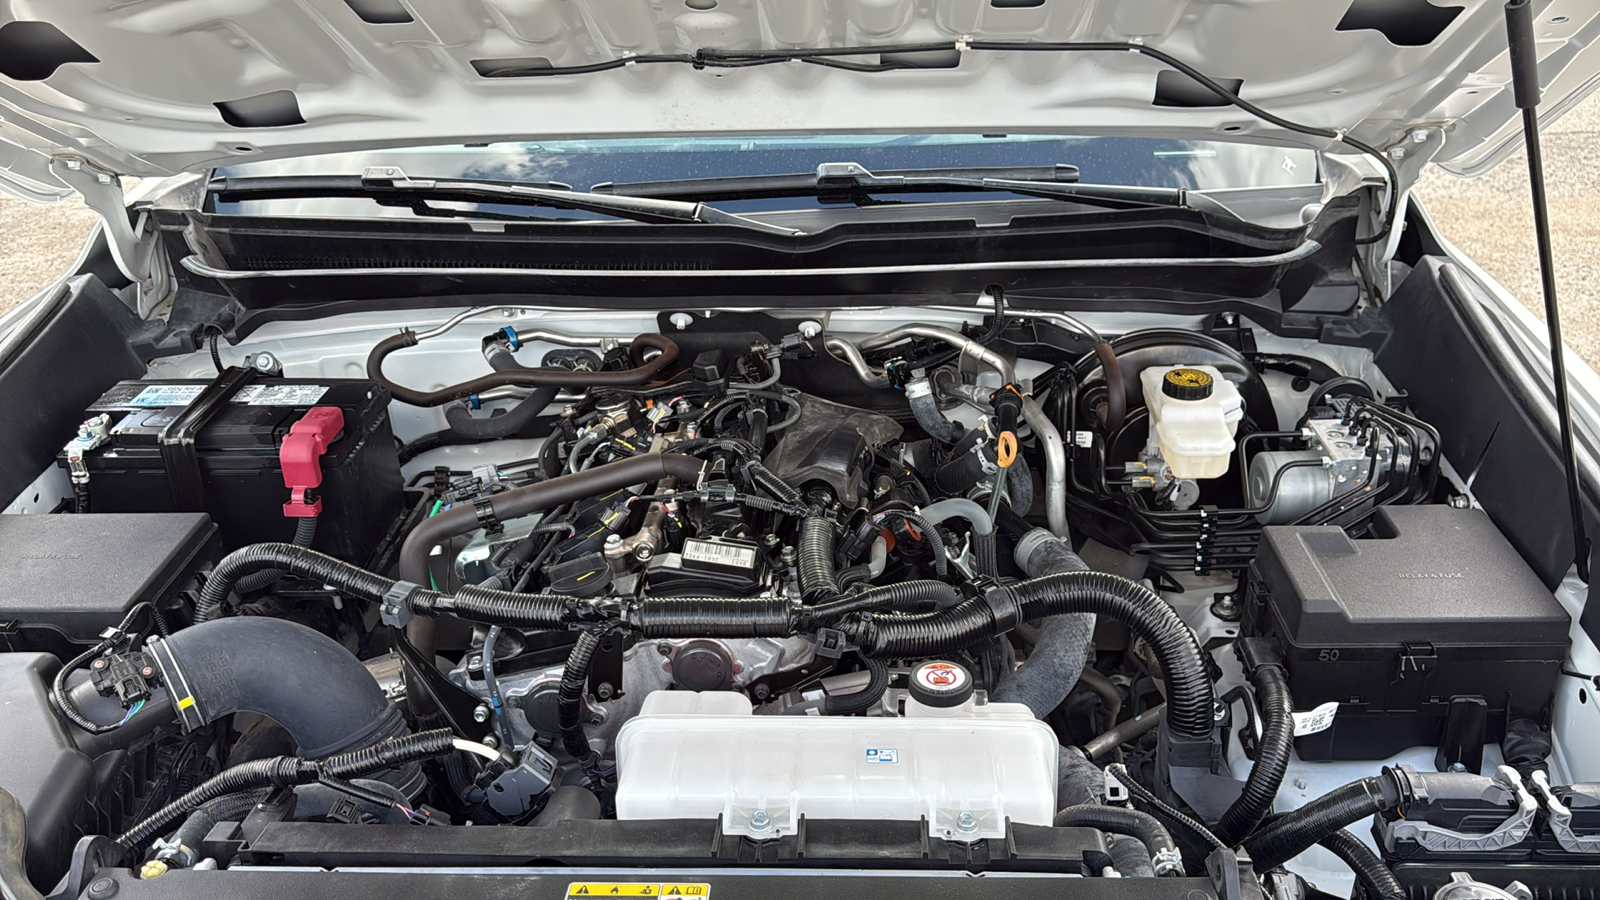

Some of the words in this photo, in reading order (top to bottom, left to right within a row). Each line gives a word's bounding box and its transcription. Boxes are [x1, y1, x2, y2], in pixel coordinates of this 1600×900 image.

[1398, 572, 1428, 580] RELAY
[1438, 572, 1465, 580] FUSE
[1318, 649, 1340, 661] 50
